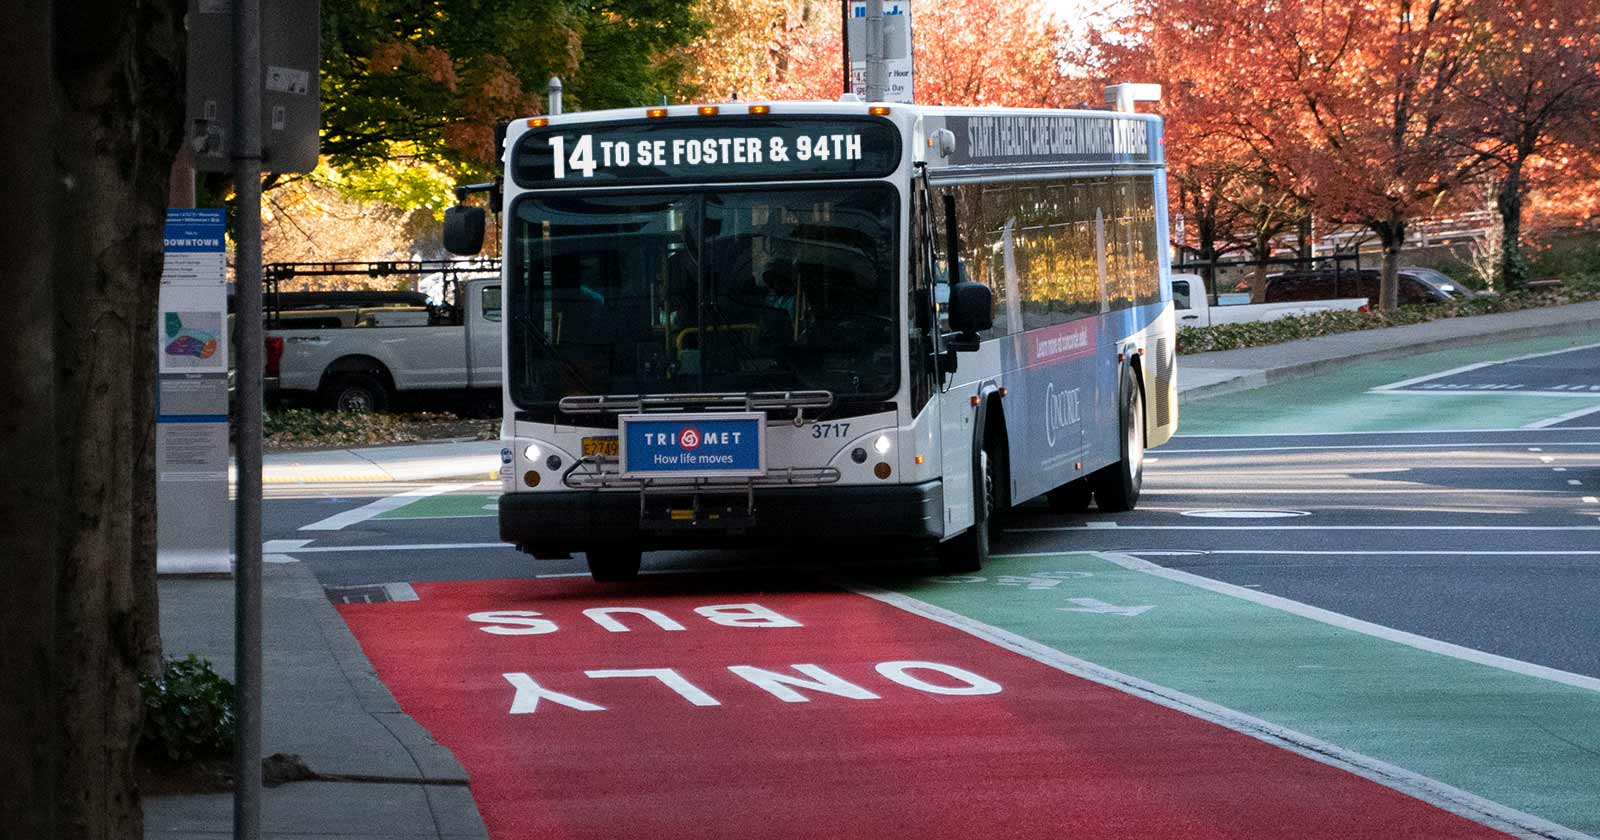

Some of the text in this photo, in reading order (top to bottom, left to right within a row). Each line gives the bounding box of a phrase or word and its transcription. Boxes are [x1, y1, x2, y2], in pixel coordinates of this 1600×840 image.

[968, 116, 993, 158] START
[994, 117, 1001, 156] A
[1001, 117, 1030, 156] HEALTH
[1030, 117, 1050, 155] CARE
[1050, 117, 1076, 155] CAREER
[1077, 118, 1085, 154] IN
[548, 134, 862, 179] 14 TO SE FOSTER & 94TH
[163, 239, 219, 247] DOWNTOWN
[645, 432, 741, 446] TRI MET
[812, 423, 851, 439] 3717
[654, 453, 734, 465] How life moves
[468, 603, 805, 635] BUS
[500, 660, 1003, 714] ONLY
